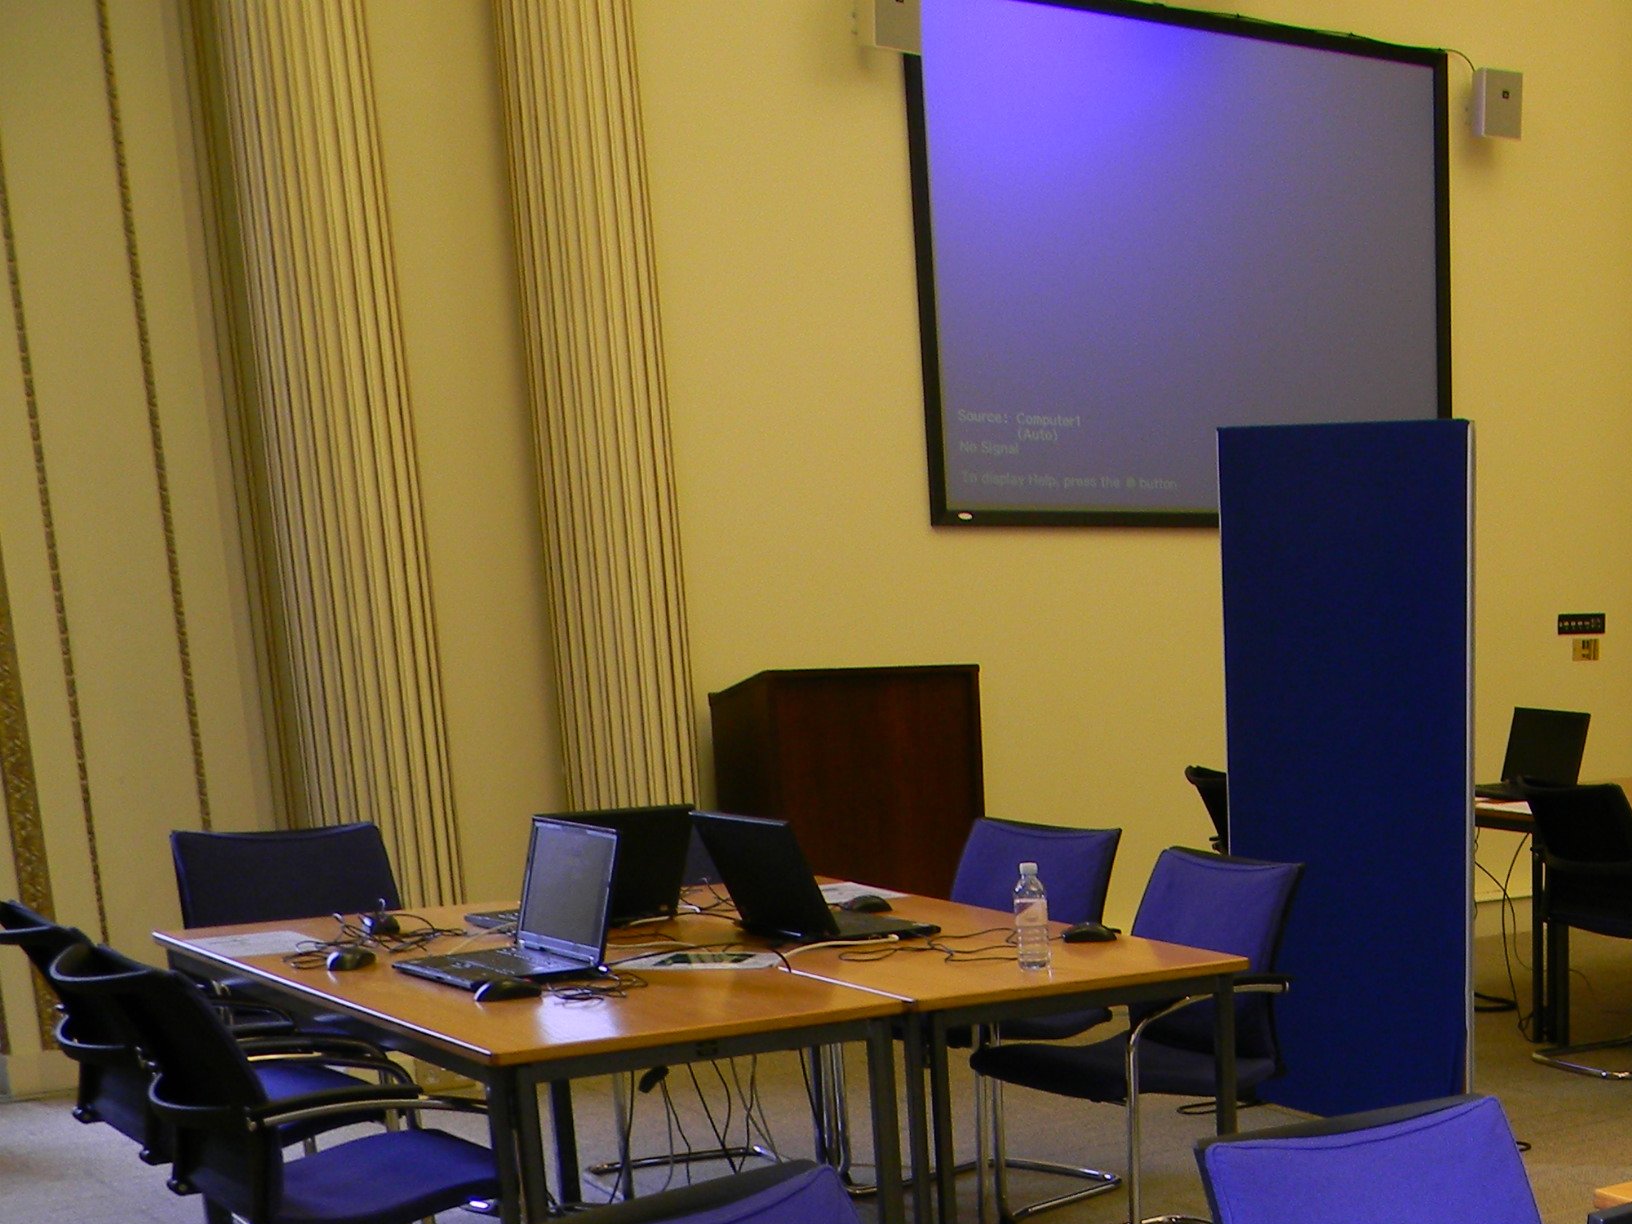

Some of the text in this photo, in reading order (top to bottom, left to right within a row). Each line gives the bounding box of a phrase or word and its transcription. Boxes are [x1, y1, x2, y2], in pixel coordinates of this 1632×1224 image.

[957, 409, 1008, 424] Source:
[960, 440, 1019, 456] No Signal
